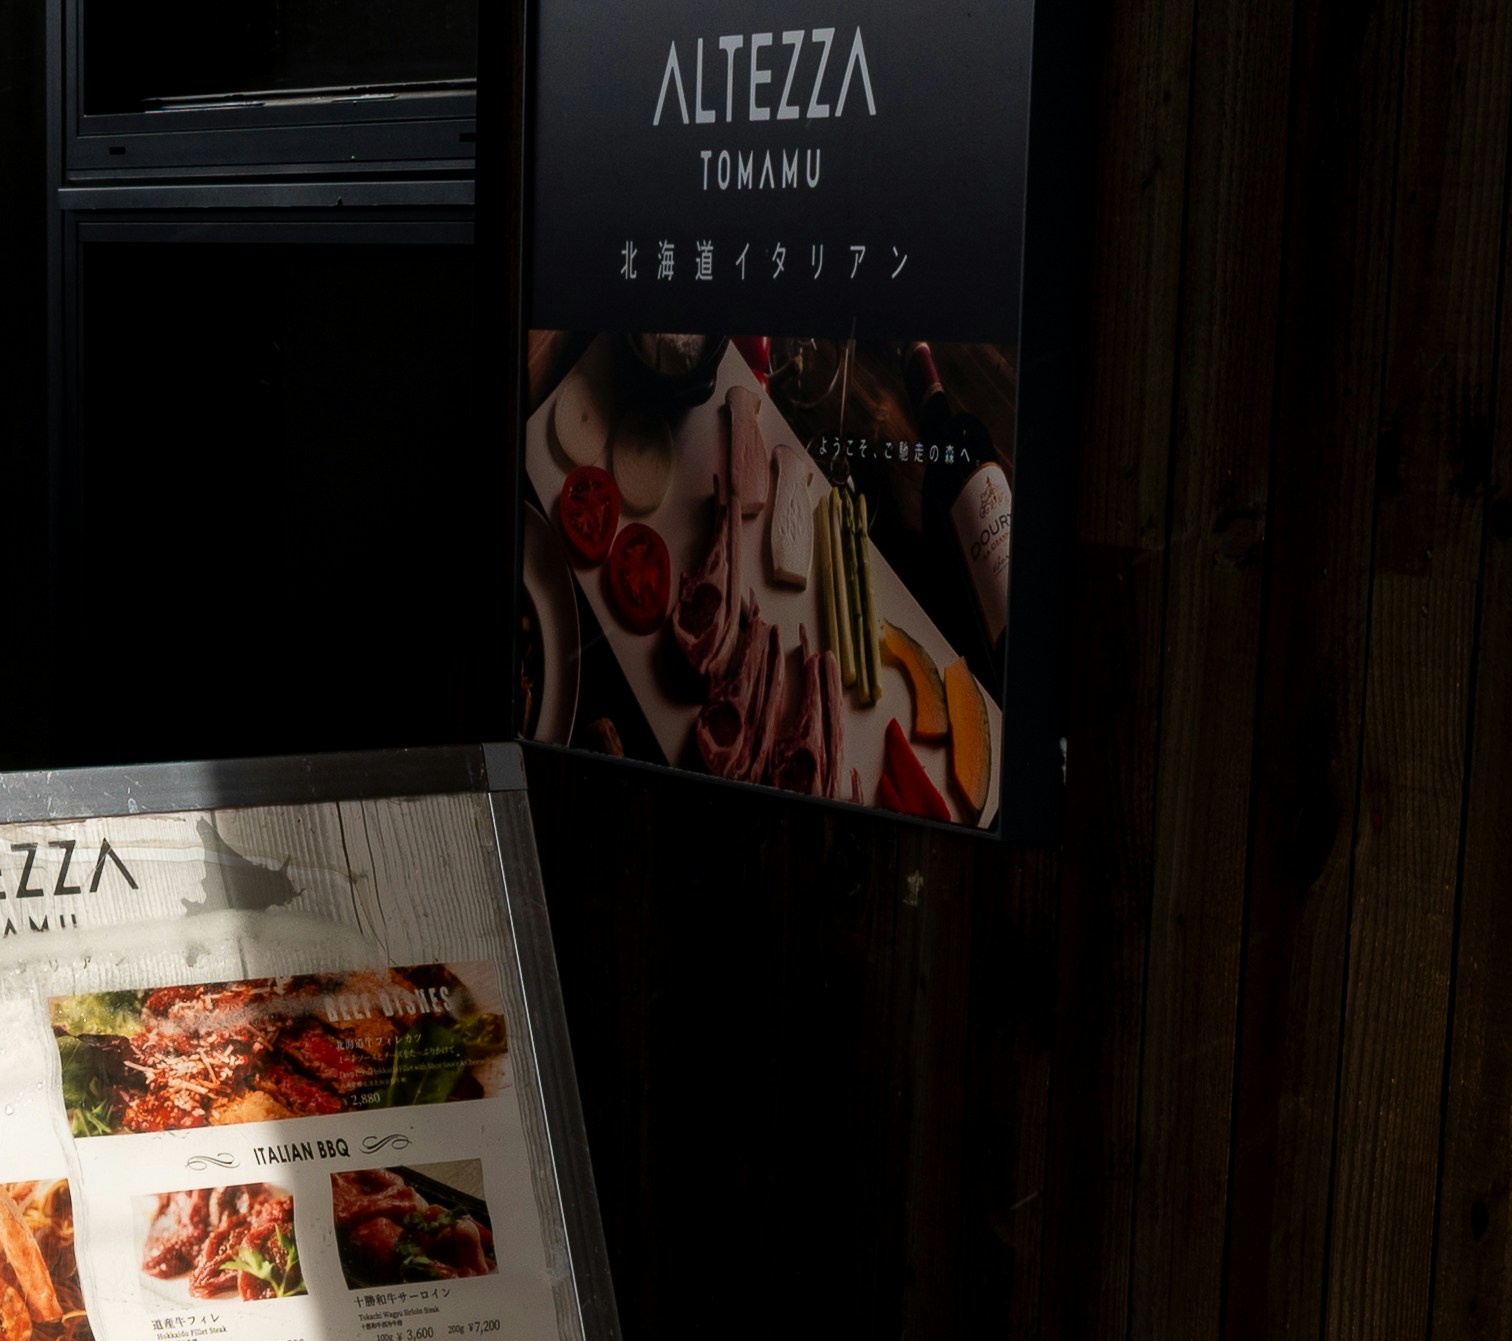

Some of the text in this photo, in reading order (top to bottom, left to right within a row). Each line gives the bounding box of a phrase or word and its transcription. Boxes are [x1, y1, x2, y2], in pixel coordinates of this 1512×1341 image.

[653, 25, 877, 125] ALTEZZA
[700, 148, 822, 191] TOMAMU
[621, 239, 909, 282] 北海道イタリアン
[253, 1138, 351, 1165] ITALIAN BBQ
[354, 1288, 450, 1308] 十勝和牛サーロイン
[152, 1314, 219, 1330] 道産牛フィレ
[448, 1325, 464, 1334] 200g
[468, 1320, 500, 1335] ¥7,200
[157, 1330, 189, 1340] Hokkaido
